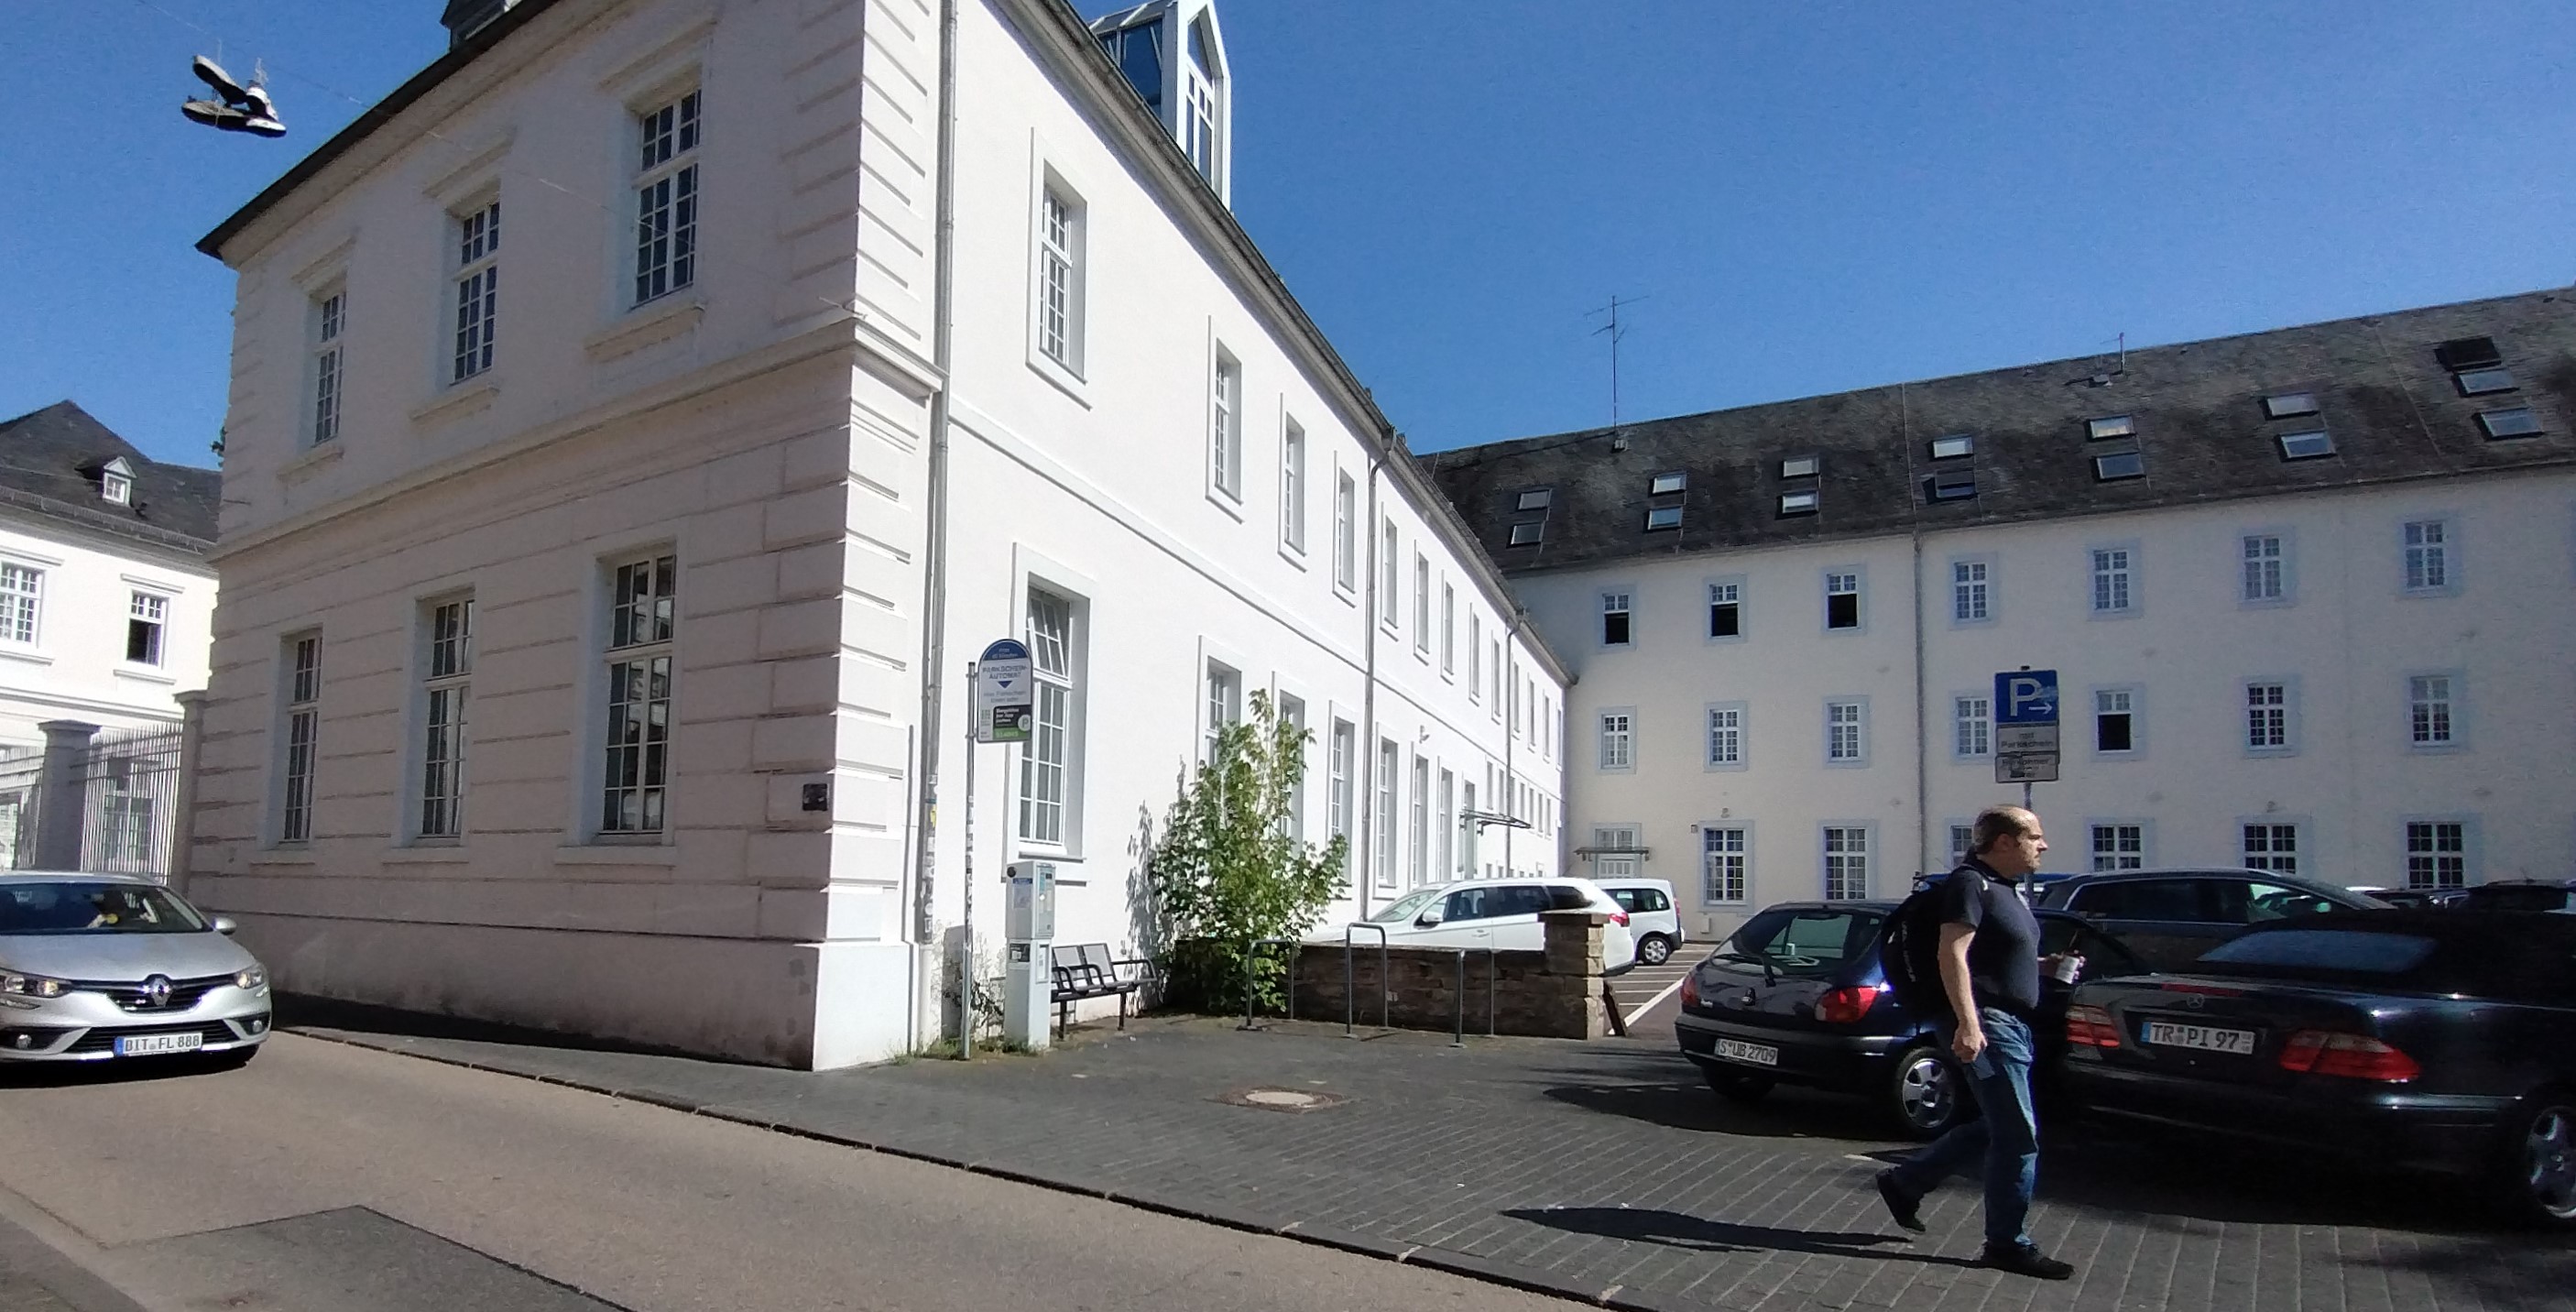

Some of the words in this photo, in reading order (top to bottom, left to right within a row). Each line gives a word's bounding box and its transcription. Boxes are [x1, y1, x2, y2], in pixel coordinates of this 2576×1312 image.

[2010, 677, 2043, 716] P
[2001, 740, 2054, 749] Parkschein
[125, 1038, 149, 1052] BIT
[158, 1037, 174, 1049] FL
[177, 1034, 200, 1047] 888
[2153, 1024, 2175, 1043] TR
[2187, 1027, 2210, 1047] PI
[2215, 1031, 2240, 1049] 97
[1719, 1041, 1727, 1054] S
[1747, 1045, 1776, 1063] 2709
